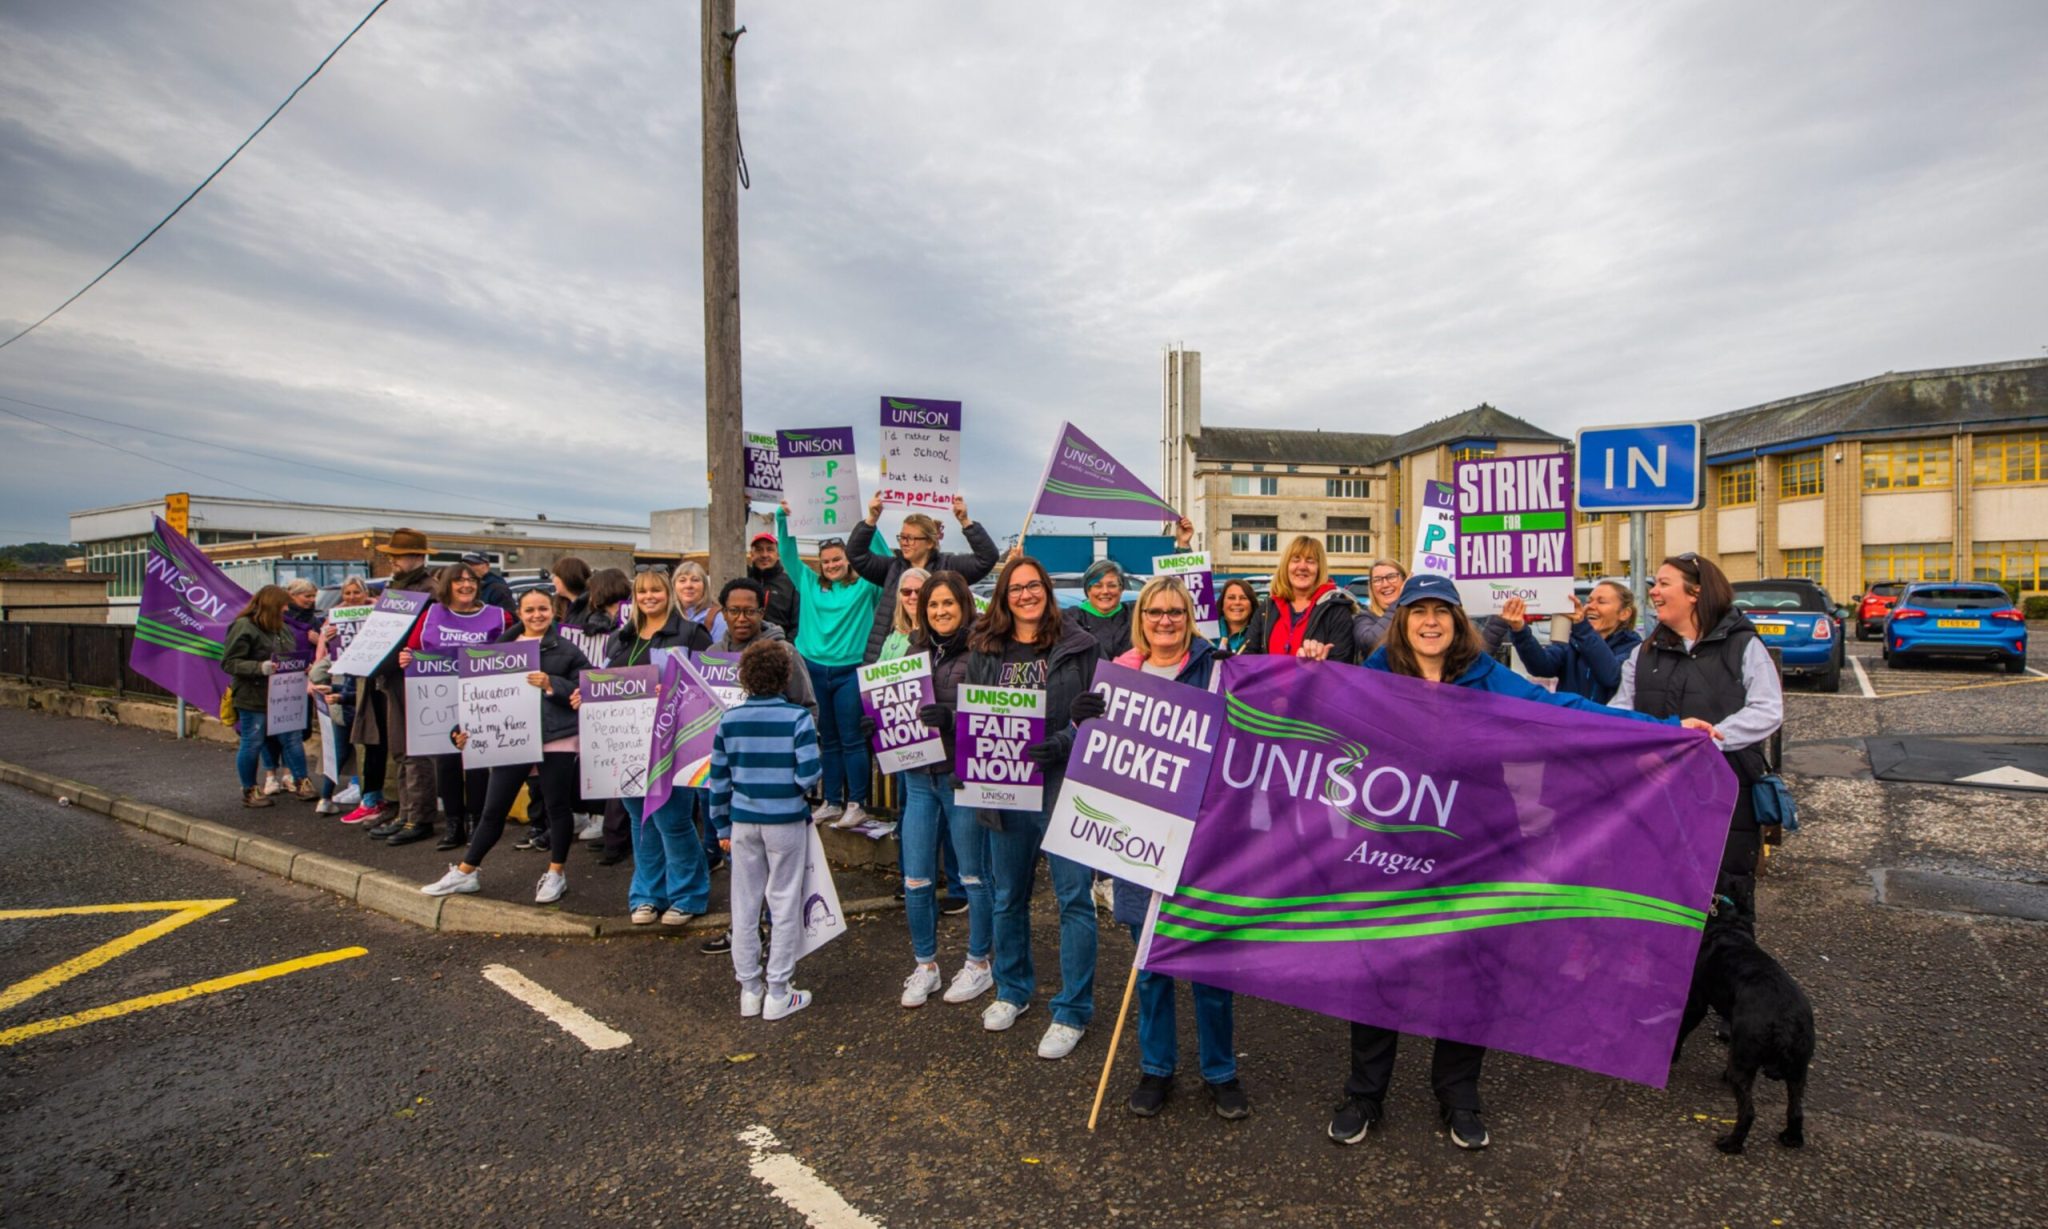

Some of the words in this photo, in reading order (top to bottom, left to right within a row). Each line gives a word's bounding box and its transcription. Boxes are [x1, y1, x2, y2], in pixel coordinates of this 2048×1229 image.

[892, 409, 949, 425] UNISON
[789, 438, 843, 453] UNISON
[905, 433, 931, 441] rather
[939, 433, 950, 442] be
[889, 447, 901, 456] at
[1064, 446, 1116, 475] UNISON
[754, 462, 781, 477] PAY
[1604, 445, 1667, 490] IN
[749, 474, 783, 490] NOW
[889, 471, 907, 482] but
[913, 474, 932, 483] this
[940, 475, 949, 484] is
[1458, 457, 1566, 514] STRIKE
[1503, 514, 1522, 530] FOR
[1158, 555, 1204, 569] UNISON
[1424, 555, 1448, 571] ON
[1460, 534, 1512, 576] FAIR
[1521, 532, 1566, 573] PAY
[1492, 589, 1537, 601] UNISON
[381, 598, 418, 611] UNISON
[168, 606, 205, 632] Angus
[440, 631, 487, 642] UNISON
[470, 653, 528, 673] UNISON
[864, 657, 922, 682] UNISON
[999, 659, 1048, 685] DKNY
[418, 684, 448, 699] NO
[462, 683, 520, 702] Education
[591, 679, 646, 698] UNISON
[871, 680, 922, 710] FAIR
[966, 688, 1037, 708] UNISON
[469, 703, 500, 722] Hero.
[586, 704, 636, 721] Working
[880, 699, 920, 728] PAY
[991, 706, 1011, 714] says
[1094, 682, 1213, 753] OFFICIAL
[464, 723, 484, 734] But
[486, 724, 501, 737] my
[593, 723, 640, 734] Peanuts
[878, 719, 929, 749] NOW
[968, 714, 1032, 740] FAIR
[471, 738, 489, 754] says
[591, 741, 600, 750] a
[607, 737, 643, 751] Peanut
[976, 737, 1027, 761] PAY
[593, 755, 617, 768] Free
[897, 750, 924, 763] UNISON
[1083, 729, 1190, 794] PICKET
[966, 757, 1034, 783] NOW
[1222, 737, 1460, 828] UNISON
[981, 791, 1016, 801] UNISON
[1070, 815, 1165, 866] UNISON
[1344, 840, 1437, 874] Angus
